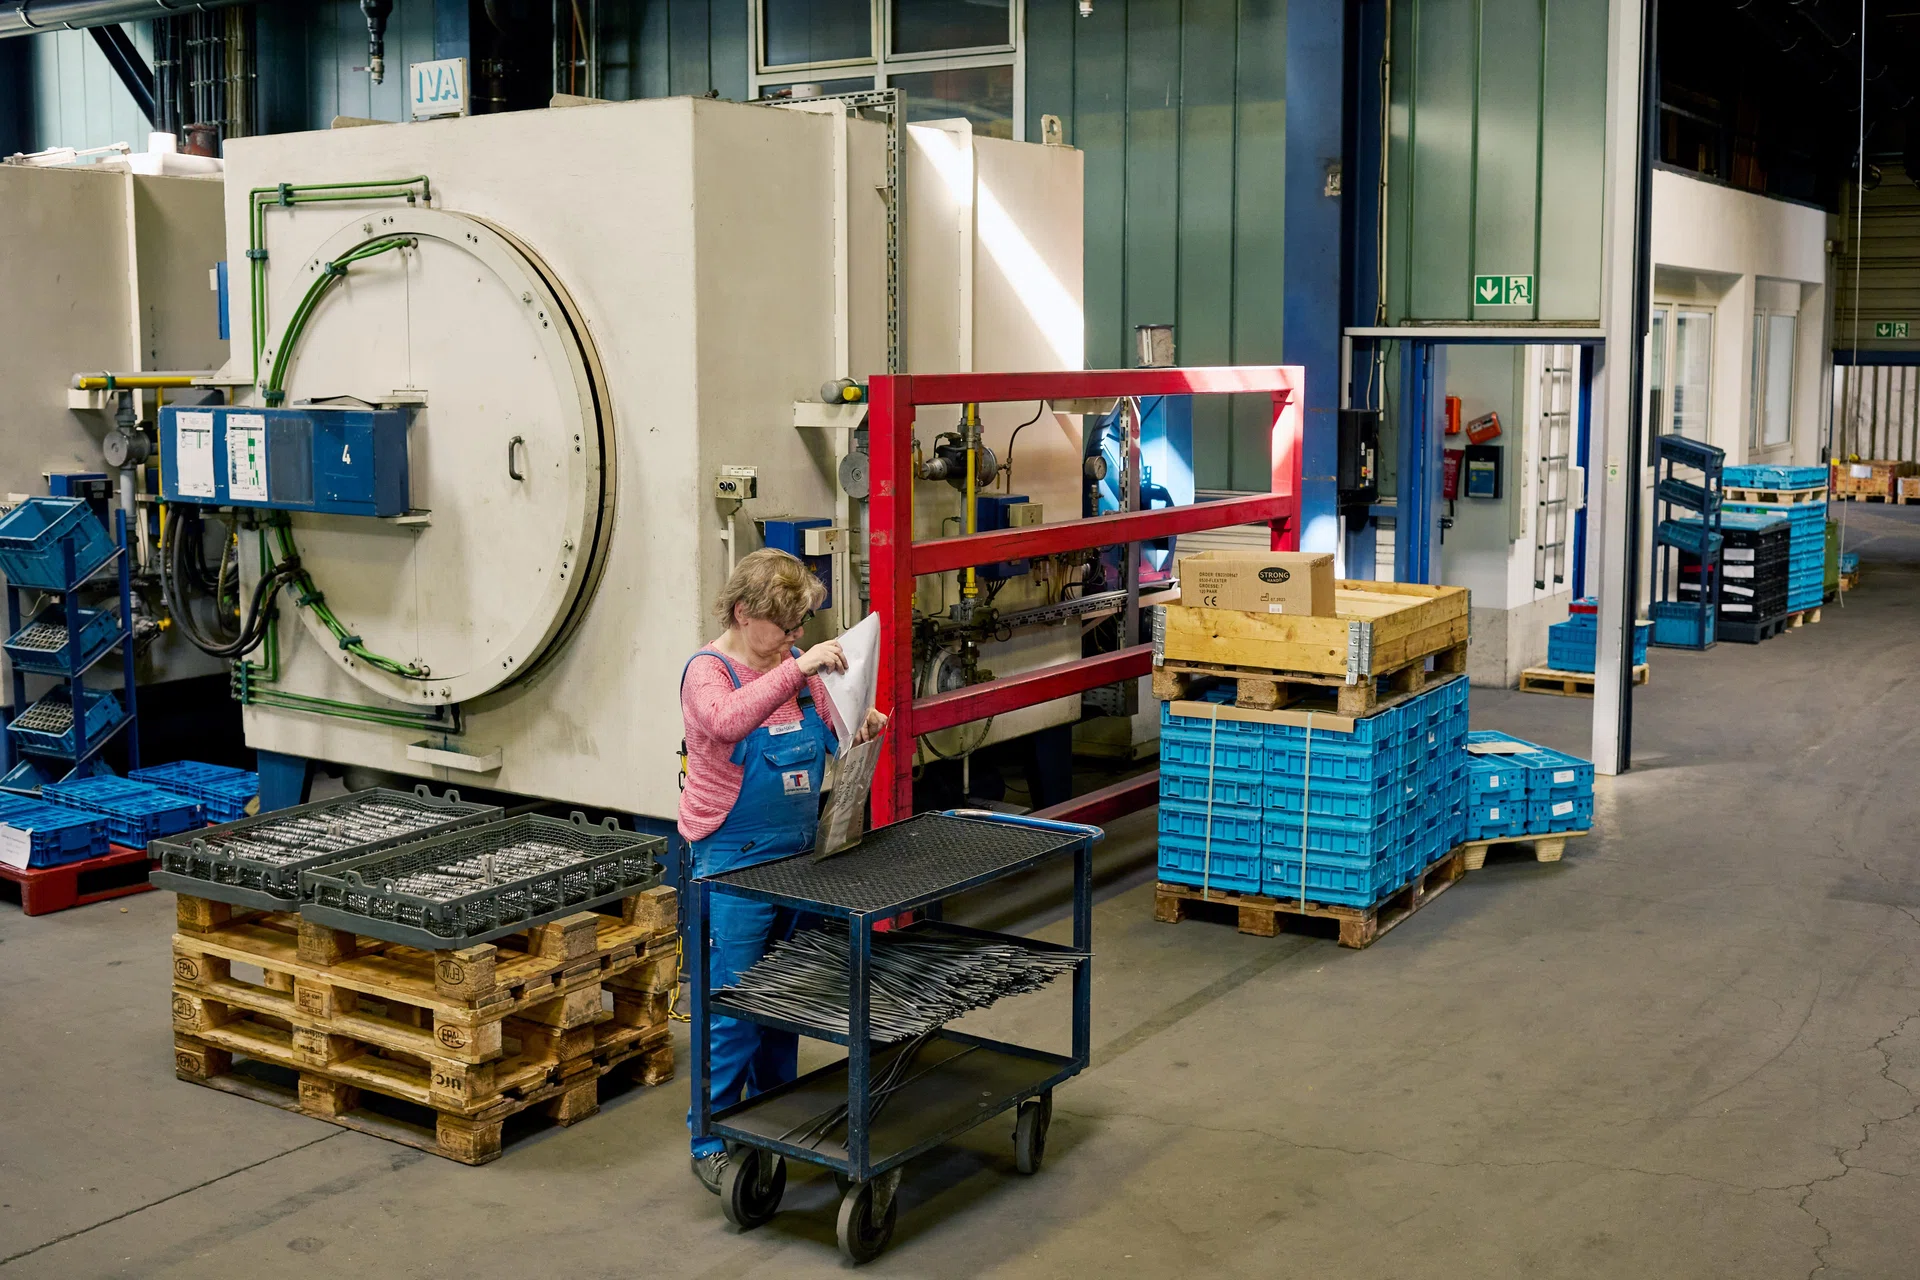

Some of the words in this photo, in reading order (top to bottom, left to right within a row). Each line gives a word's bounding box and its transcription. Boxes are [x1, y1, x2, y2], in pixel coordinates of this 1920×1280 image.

[415, 65, 459, 103] IVA
[342, 444, 351, 465] 4
[1259, 571, 1289, 579] STRONG
[1203, 595, 1217, 607] CE
[179, 962, 196, 980] EPAL
